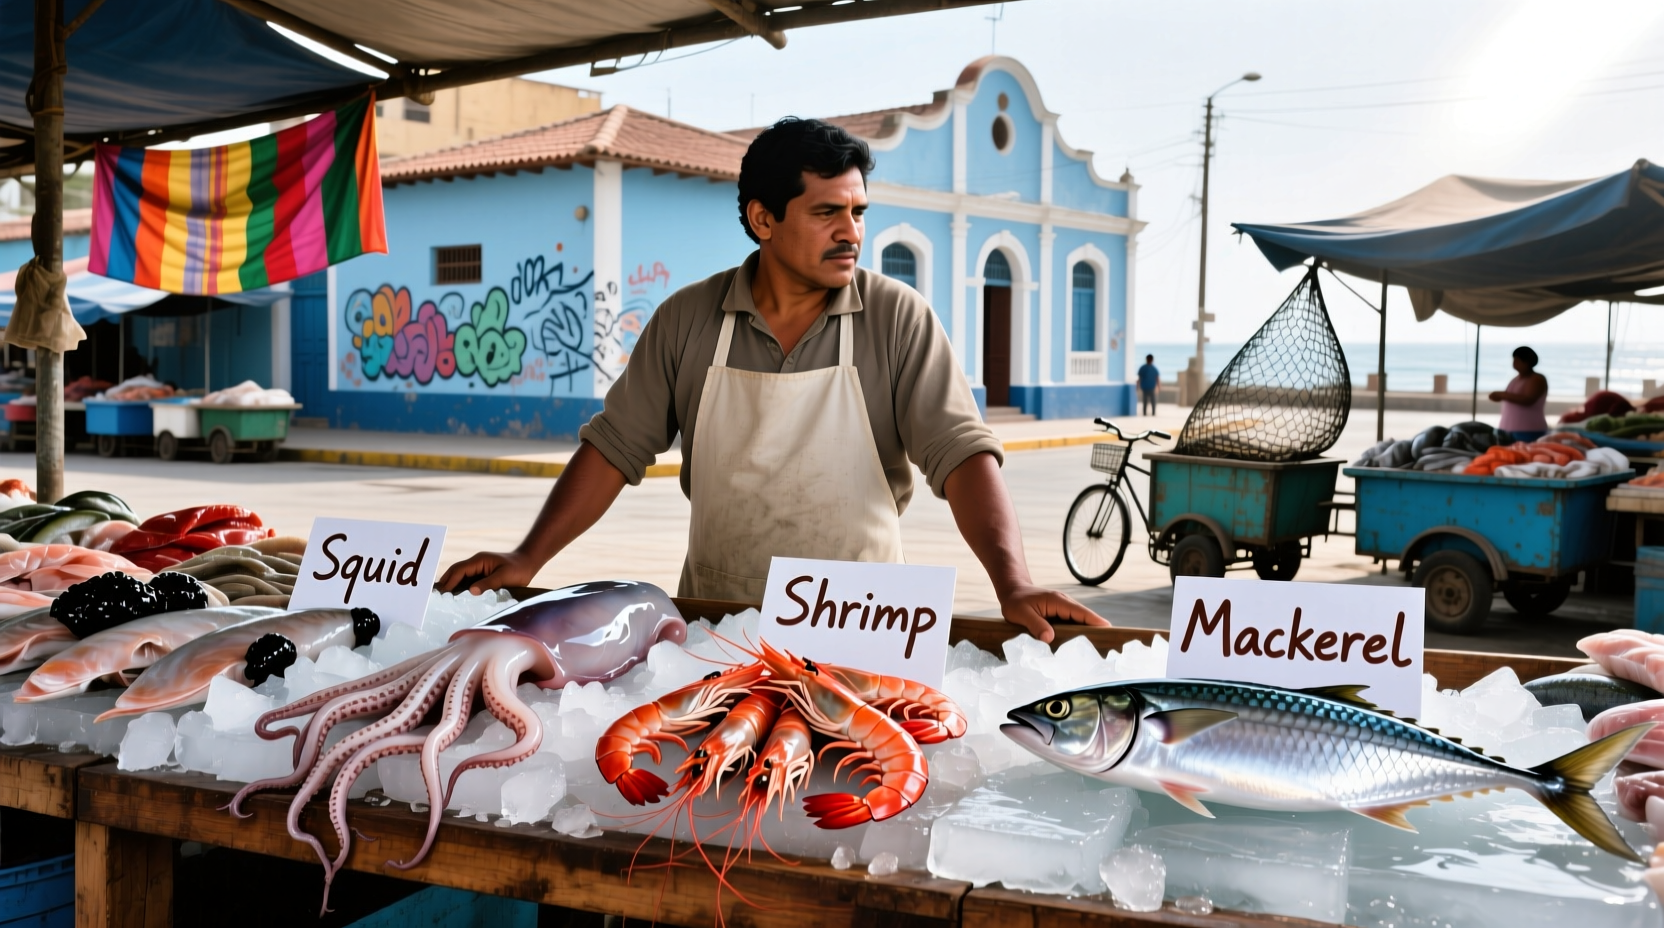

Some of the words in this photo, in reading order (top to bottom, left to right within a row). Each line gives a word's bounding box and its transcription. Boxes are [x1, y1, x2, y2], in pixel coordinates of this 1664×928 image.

[312, 532, 430, 605] Squid
[775, 575, 937, 659] Shrimp
[1180, 598, 1413, 668] Mackerel
